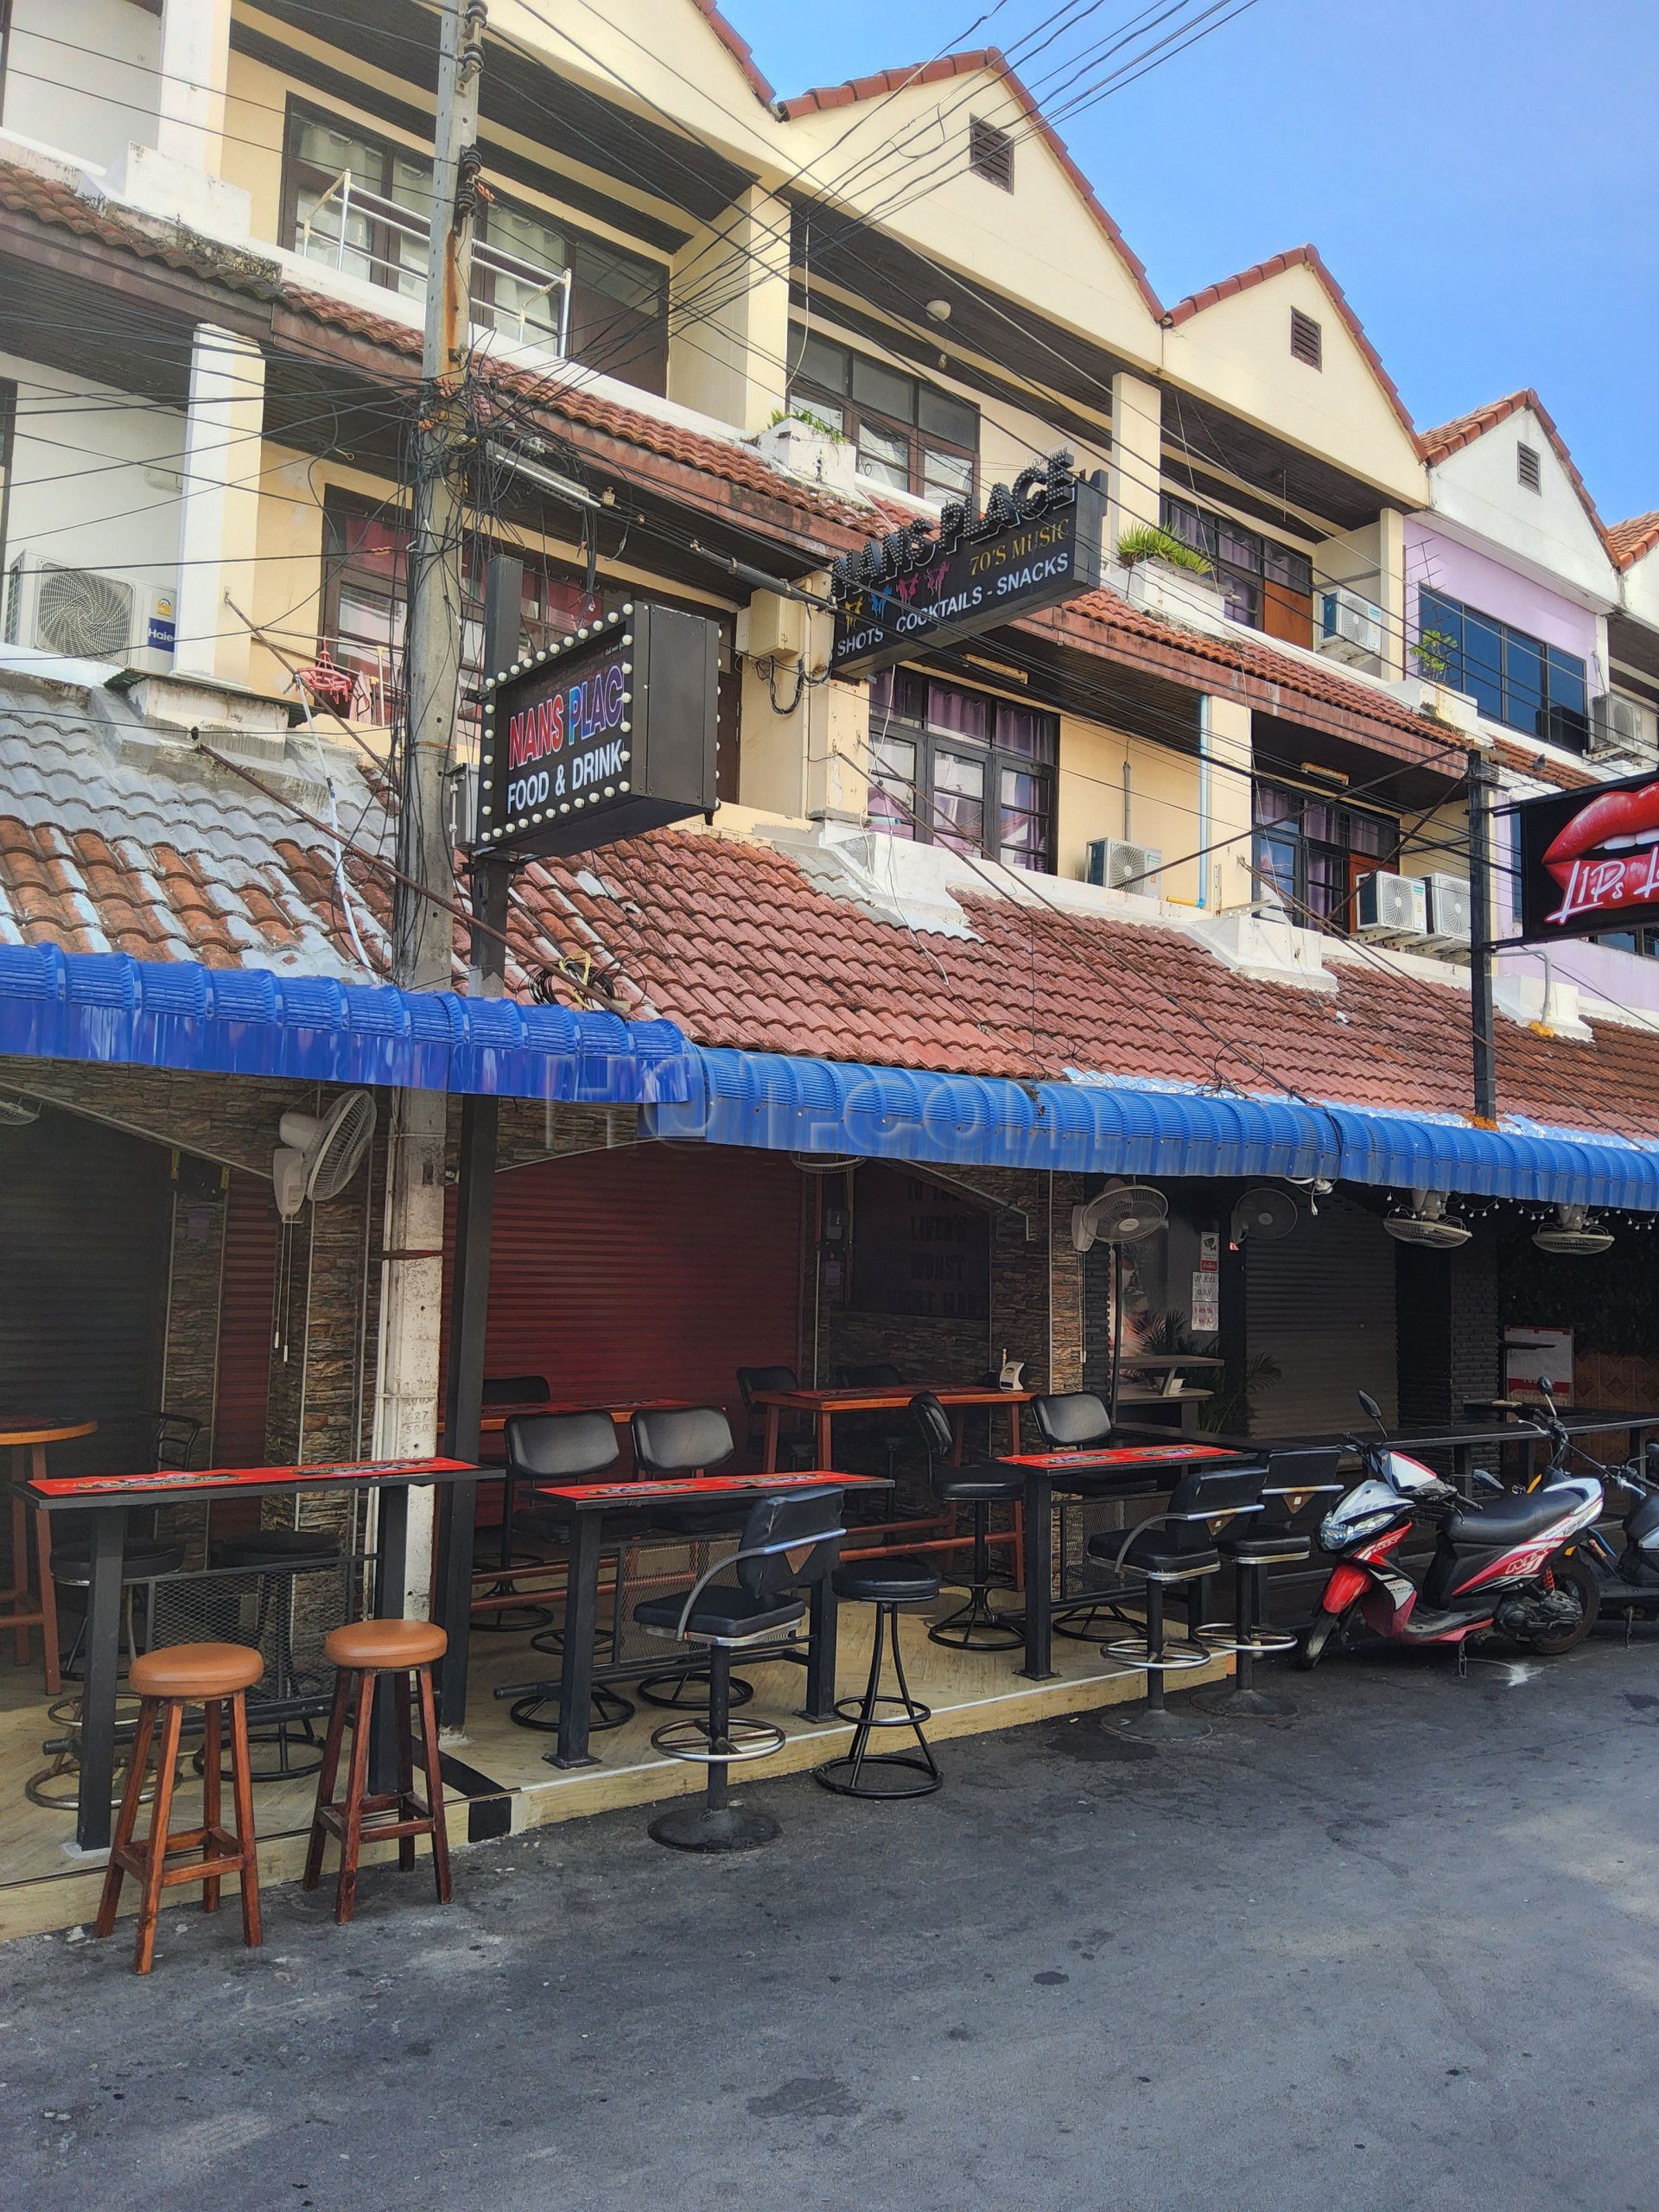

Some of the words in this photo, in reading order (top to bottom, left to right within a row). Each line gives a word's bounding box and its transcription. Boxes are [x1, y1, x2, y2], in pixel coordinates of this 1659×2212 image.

[938, 451, 1071, 550] PLACE
[969, 545, 1007, 576] 70'S
[1012, 518, 1070, 560] MUSIC
[148, 627, 175, 642] Haie
[836, 627, 884, 657] SHOTS
[896, 586, 982, 633] COCKTAILS
[996, 552, 1068, 596] SNACKS
[508, 694, 564, 771] NANS
[569, 663, 625, 746] PLAC
[507, 771, 550, 814] FOOD
[555, 764, 566, 797] &
[572, 739, 624, 791] DRINK
[1633, 846, 1659, 899] L
